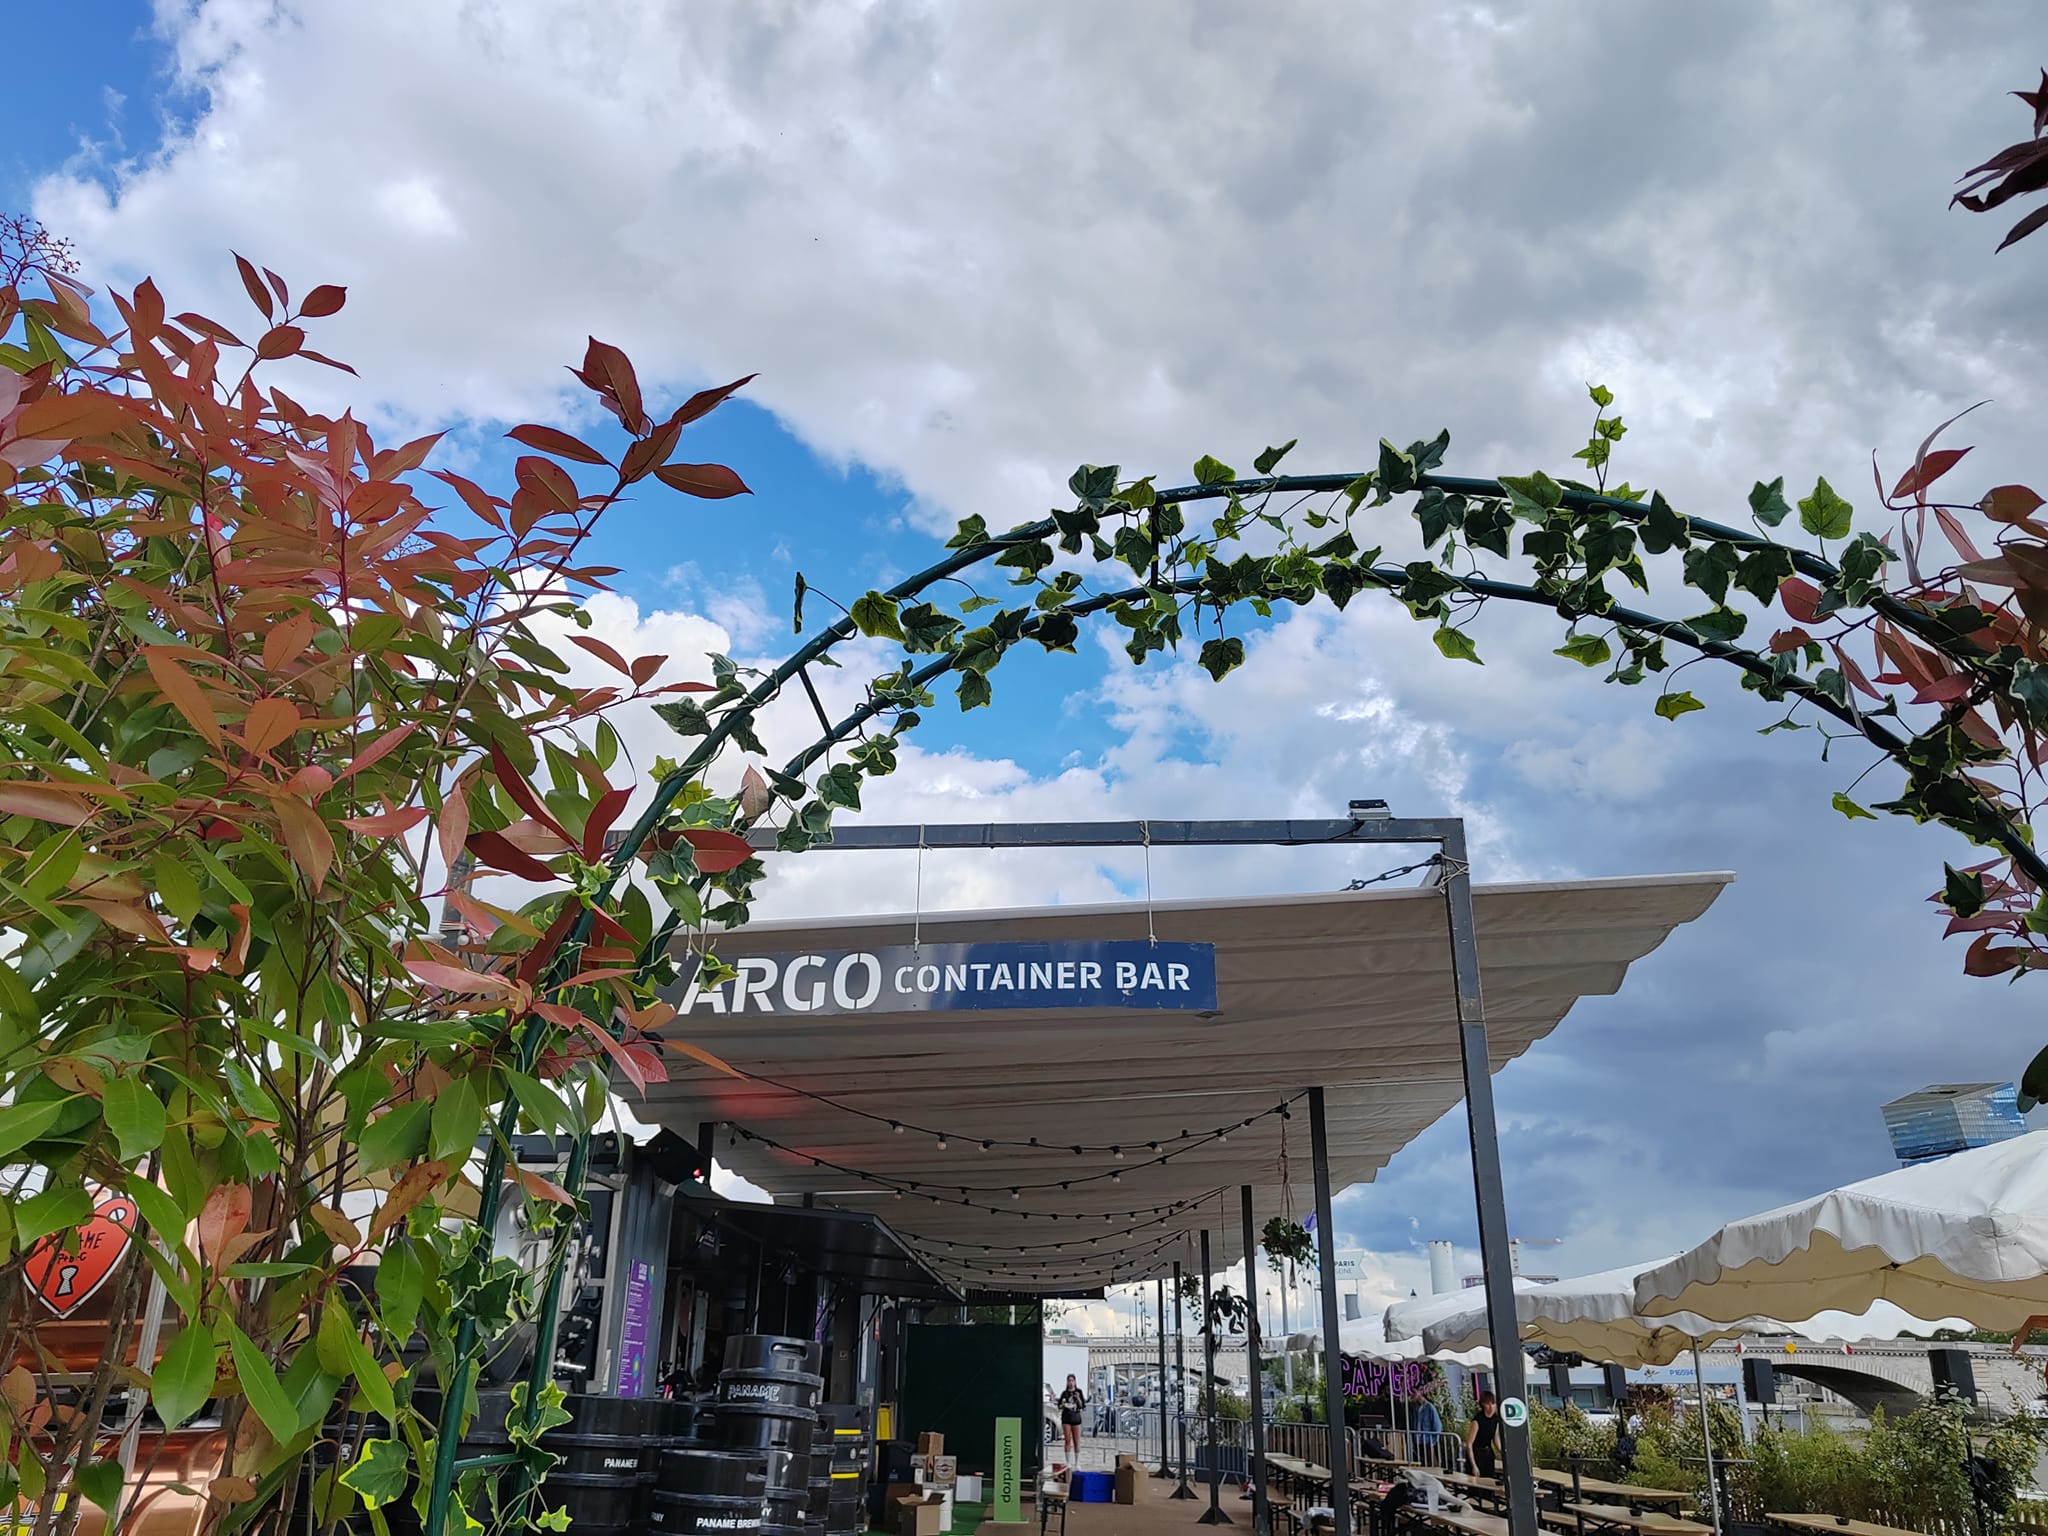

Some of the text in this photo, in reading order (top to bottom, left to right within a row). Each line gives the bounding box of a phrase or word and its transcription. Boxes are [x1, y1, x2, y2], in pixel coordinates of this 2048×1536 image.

[671, 952, 1190, 1015] ARGO CONTAINER BAR
[1000, 1435, 1013, 1503] waterdrop
[696, 1517, 736, 1529] PANAME
